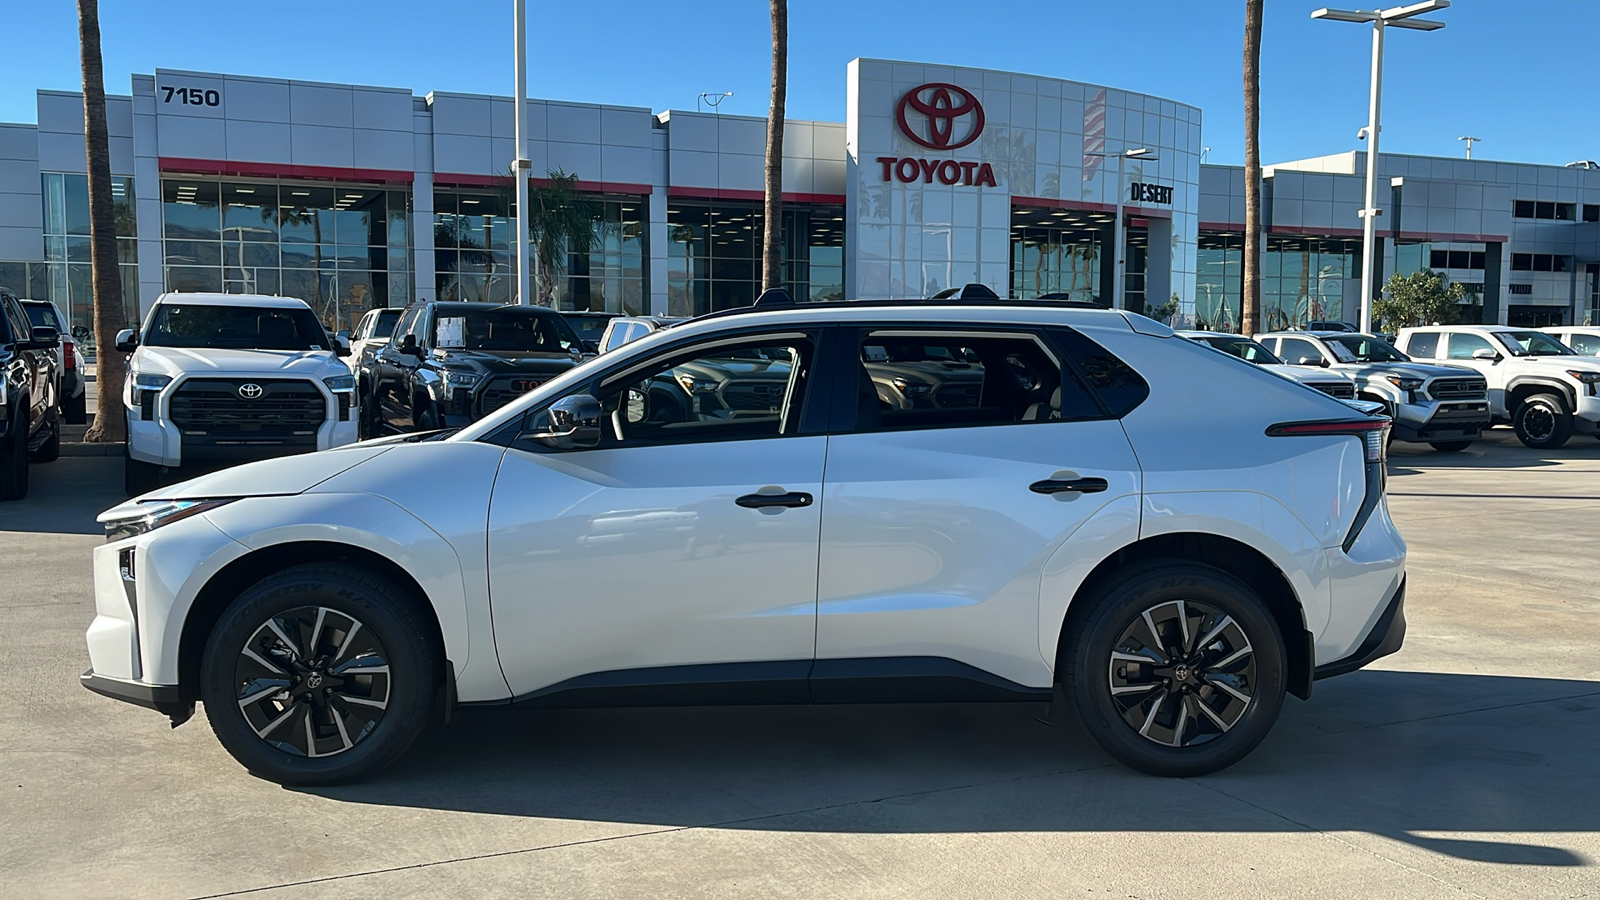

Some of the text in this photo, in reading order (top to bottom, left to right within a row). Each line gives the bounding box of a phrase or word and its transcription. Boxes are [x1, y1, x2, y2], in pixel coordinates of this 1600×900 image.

[161, 86, 220, 107] 7150
[876, 157, 997, 187] TOYOTA
[1131, 182, 1174, 205] DESERT
